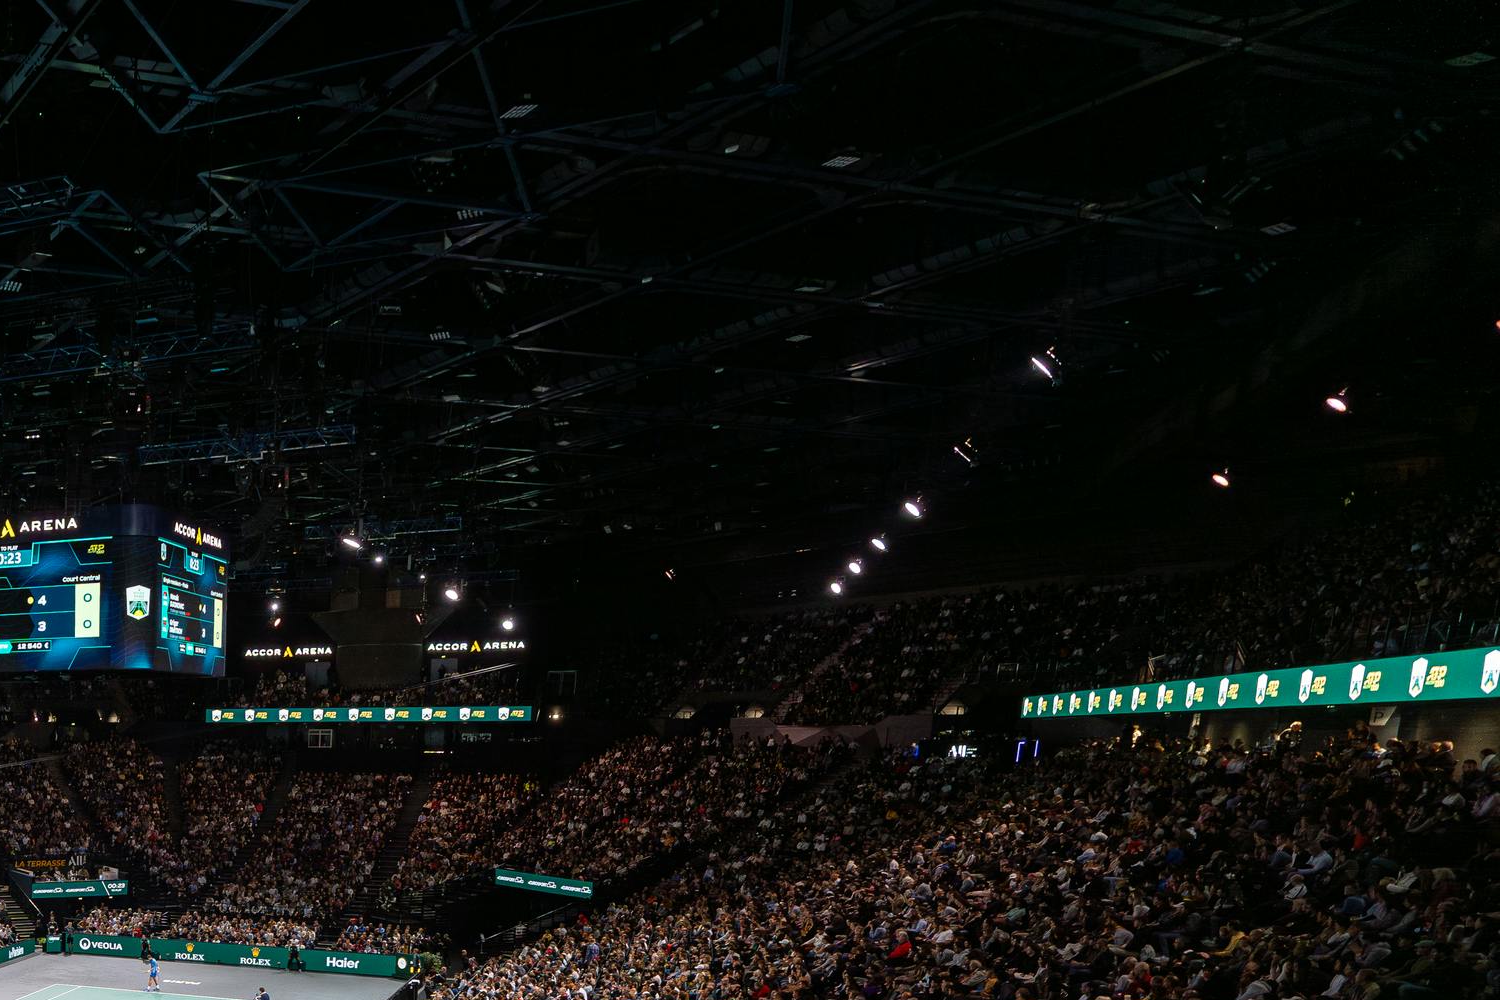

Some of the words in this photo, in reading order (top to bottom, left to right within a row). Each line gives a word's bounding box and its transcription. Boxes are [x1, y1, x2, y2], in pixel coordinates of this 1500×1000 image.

[19, 517, 78, 533] ARENA
[174, 521, 196, 539] ACCOR
[202, 532, 222, 549] ARENA
[62, 575, 79, 583] Court
[79, 574, 101, 582] Central
[37, 595, 47, 606] 4
[83, 593, 93, 603] 0
[37, 621, 47, 632] 3
[83, 619, 92, 629] 0
[428, 642, 468, 651] ACCOR
[483, 641, 525, 650] ARENA
[245, 648, 281, 657] ACCOR
[295, 647, 333, 656] ARENA
[15, 860, 26, 868] LA
[27, 859, 66, 868] TERRASSE
[91, 941, 123, 951] VEOLIA
[175, 952, 204, 961] ROLEX
[240, 957, 271, 966] ROLEX
[326, 956, 360, 969] Haier
